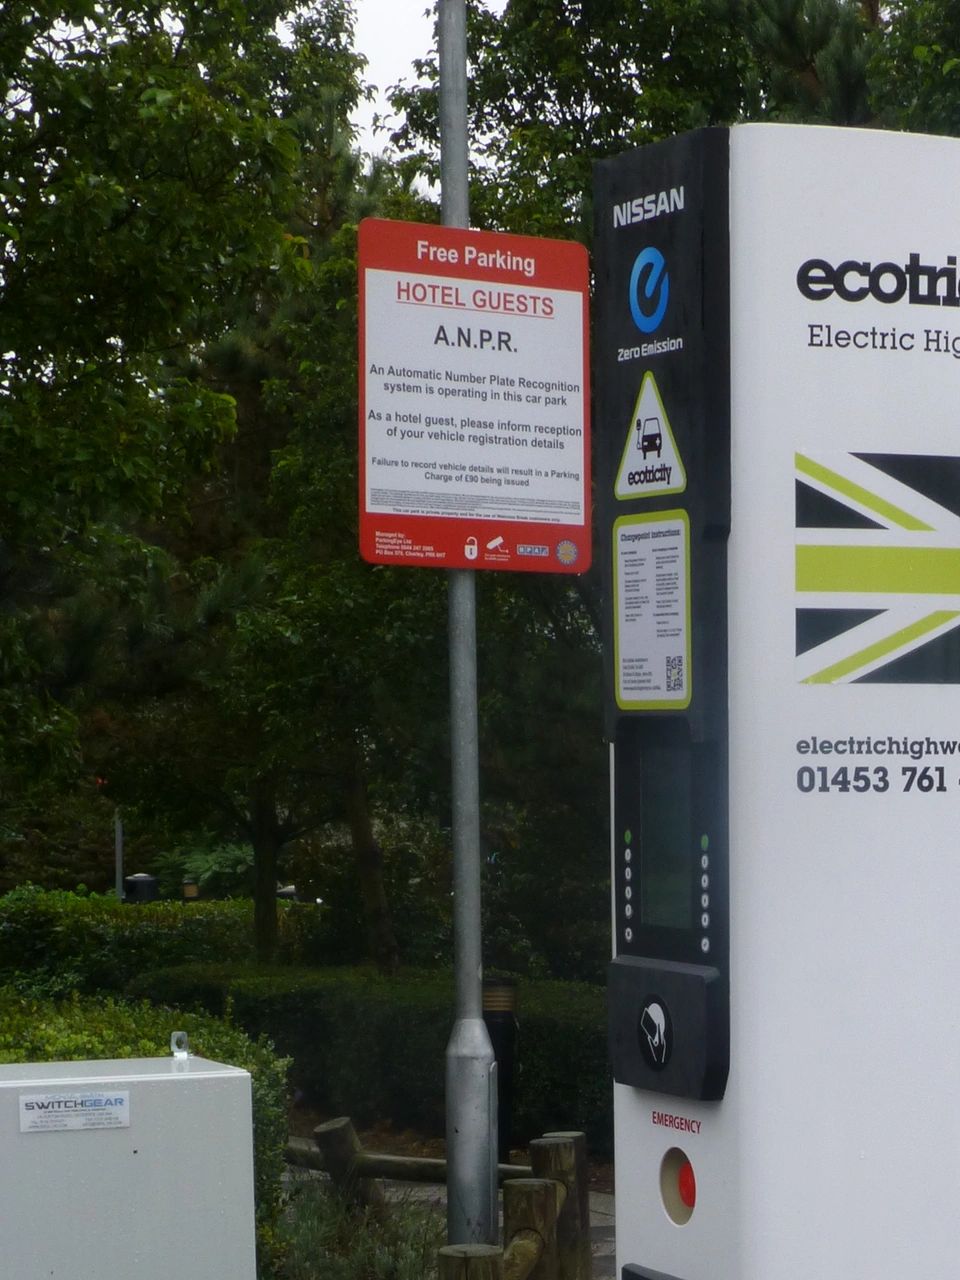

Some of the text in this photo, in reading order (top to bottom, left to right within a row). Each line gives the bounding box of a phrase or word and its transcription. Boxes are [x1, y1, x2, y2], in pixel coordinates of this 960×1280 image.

[613, 185, 684, 228] NISSAN
[417, 240, 535, 277] Free Parking
[397, 281, 554, 315] HOTEL GUESTS
[434, 325, 517, 352] A.N.P.R.
[618, 337, 683, 362] Zero Emission
[808, 323, 915, 352] Electric
[370, 364, 580, 392] An Automatic Number Plate Recognition
[384, 382, 567, 406] system is operating in this car park
[368, 409, 582, 437] As a hotel guest, please inform reception
[386, 426, 565, 449] of your vehicle registration details
[372, 457, 399, 466] Failure
[411, 461, 436, 469] record
[439, 462, 466, 471] vehicle
[469, 464, 494, 473] details
[512, 468, 533, 476] result
[551, 470, 579, 481] Parking
[425, 472, 452, 483] Charge
[481, 475, 502, 486] being
[504, 478, 529, 487] issued
[628, 464, 672, 485] ecotricity
[796, 766, 890, 793] 01453
[901, 766, 947, 793] 761
[25, 1097, 124, 1111] SWITCHGEAR
[652, 1110, 701, 1134] EMERGENCY
